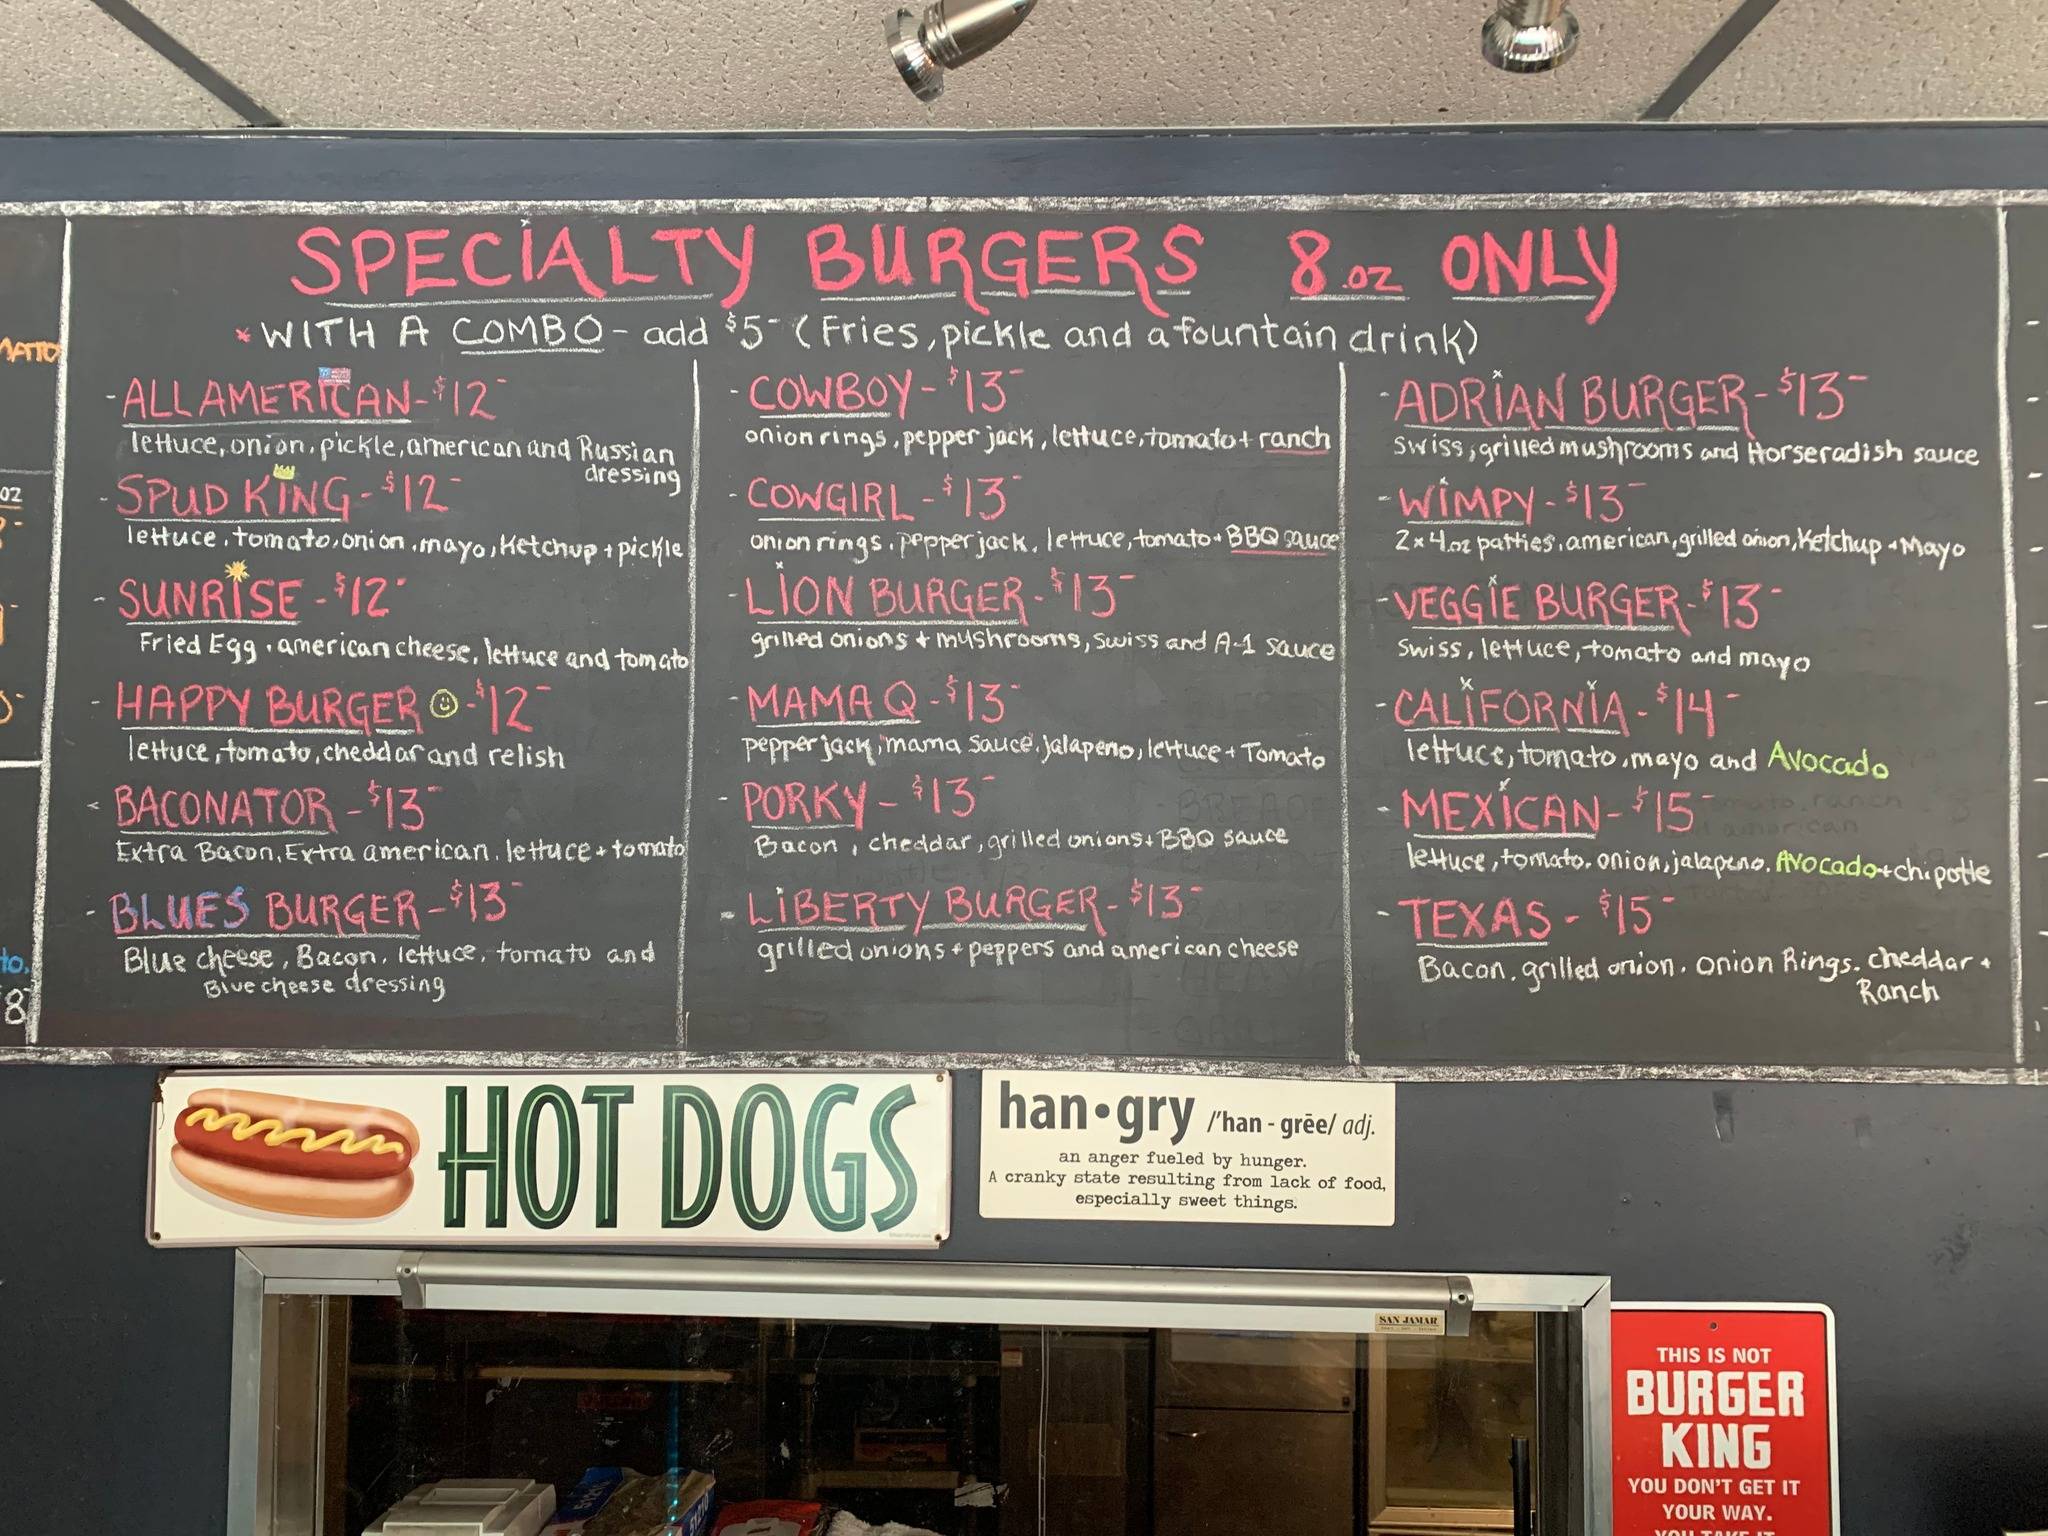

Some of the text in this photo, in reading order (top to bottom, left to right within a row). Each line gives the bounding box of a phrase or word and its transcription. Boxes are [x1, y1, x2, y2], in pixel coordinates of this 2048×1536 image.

[292, 223, 1619, 325] SPECIALTY BURGERS 8 ONLY
[262, 315, 375, 350] WITH
[399, 313, 430, 349] A
[453, 312, 605, 348] COMBO
[643, 313, 710, 348] add
[941, 317, 1052, 360] pickle
[1064, 320, 1134, 350] and
[1171, 313, 1338, 352] fountain
[750, 369, 912, 420] COWBOY
[1394, 372, 1568, 431] ADRIAN
[1582, 373, 1756, 440] BURGER
[527, 438, 571, 461] and
[577, 434, 675, 465] Russian
[1259, 424, 1332, 450] ranch
[1560, 435, 1692, 466] mushrooms
[1700, 441, 1739, 463] and
[1748, 438, 1904, 466] Horseradish
[1914, 444, 1980, 466] sauce
[116, 473, 350, 522] SPUD KING
[585, 464, 681, 497] dressing
[747, 477, 915, 521] COWGIRL
[1399, 484, 1534, 528] WIMPY
[618, 535, 684, 567] pickle
[1225, 524, 1279, 548] BBQ
[1284, 530, 1341, 551] sauce
[118, 577, 304, 620] SUNRISE
[745, 572, 1029, 627] LION BURGER
[1394, 581, 1692, 637] VEGGIE BURGER
[140, 631, 690, 672] Fried american lettuce and tomato
[750, 630, 824, 659] grilled
[830, 627, 909, 651] onions
[1165, 629, 1207, 652] and
[1266, 636, 1337, 662] sauce
[1582, 639, 1812, 681] tomato and mayo
[116, 680, 251, 728] HAPPY
[266, 683, 425, 737] BURGER
[748, 682, 875, 724] MAMA
[1394, 686, 1631, 738] CALIFORNIA
[323, 740, 566, 769] cheddar and relish
[1240, 740, 1327, 770] Tomato
[1632, 740, 1891, 780] mayo and Avocado
[114, 784, 338, 833] BACONATOR
[742, 780, 868, 832] PORKY
[1401, 788, 1600, 834] MEXICAN
[116, 839, 188, 864] Extra
[285, 841, 356, 865] Extra
[611, 835, 685, 861] tomato
[988, 827, 1061, 861] grilled
[1224, 827, 1290, 849] sauce
[109, 884, 421, 937] BLUES BURGER
[748, 884, 1108, 937] LIBERTY BURGER
[1397, 896, 1552, 941] TEXAS
[123, 940, 657, 975] Blue tomato and
[757, 934, 1300, 973] grilled onions peppers and american cheese
[1522, 945, 1974, 994] grilled cheddar
[204, 967, 446, 1003] Blue cheese dressing
[1857, 977, 1941, 1007] Ranch
[1343, 1112, 1376, 1142] adj.
[438, 1082, 918, 1233] HOT DOGS
[1059, 1150, 1308, 1170] an anger fueled by hunger.
[988, 1170, 1387, 1193] A cranky state resulting from lack of food,
[1075, 1191, 1298, 1213] especially sweet things.
[1657, 1347, 1772, 1364] THIS IS NOT
[1627, 1369, 1805, 1417] BURGER
[1662, 1422, 1772, 1470] KING
[1628, 1478, 1801, 1496] YOU DON'T GET IT
[1663, 1504, 1773, 1522] YOUR WAY.
